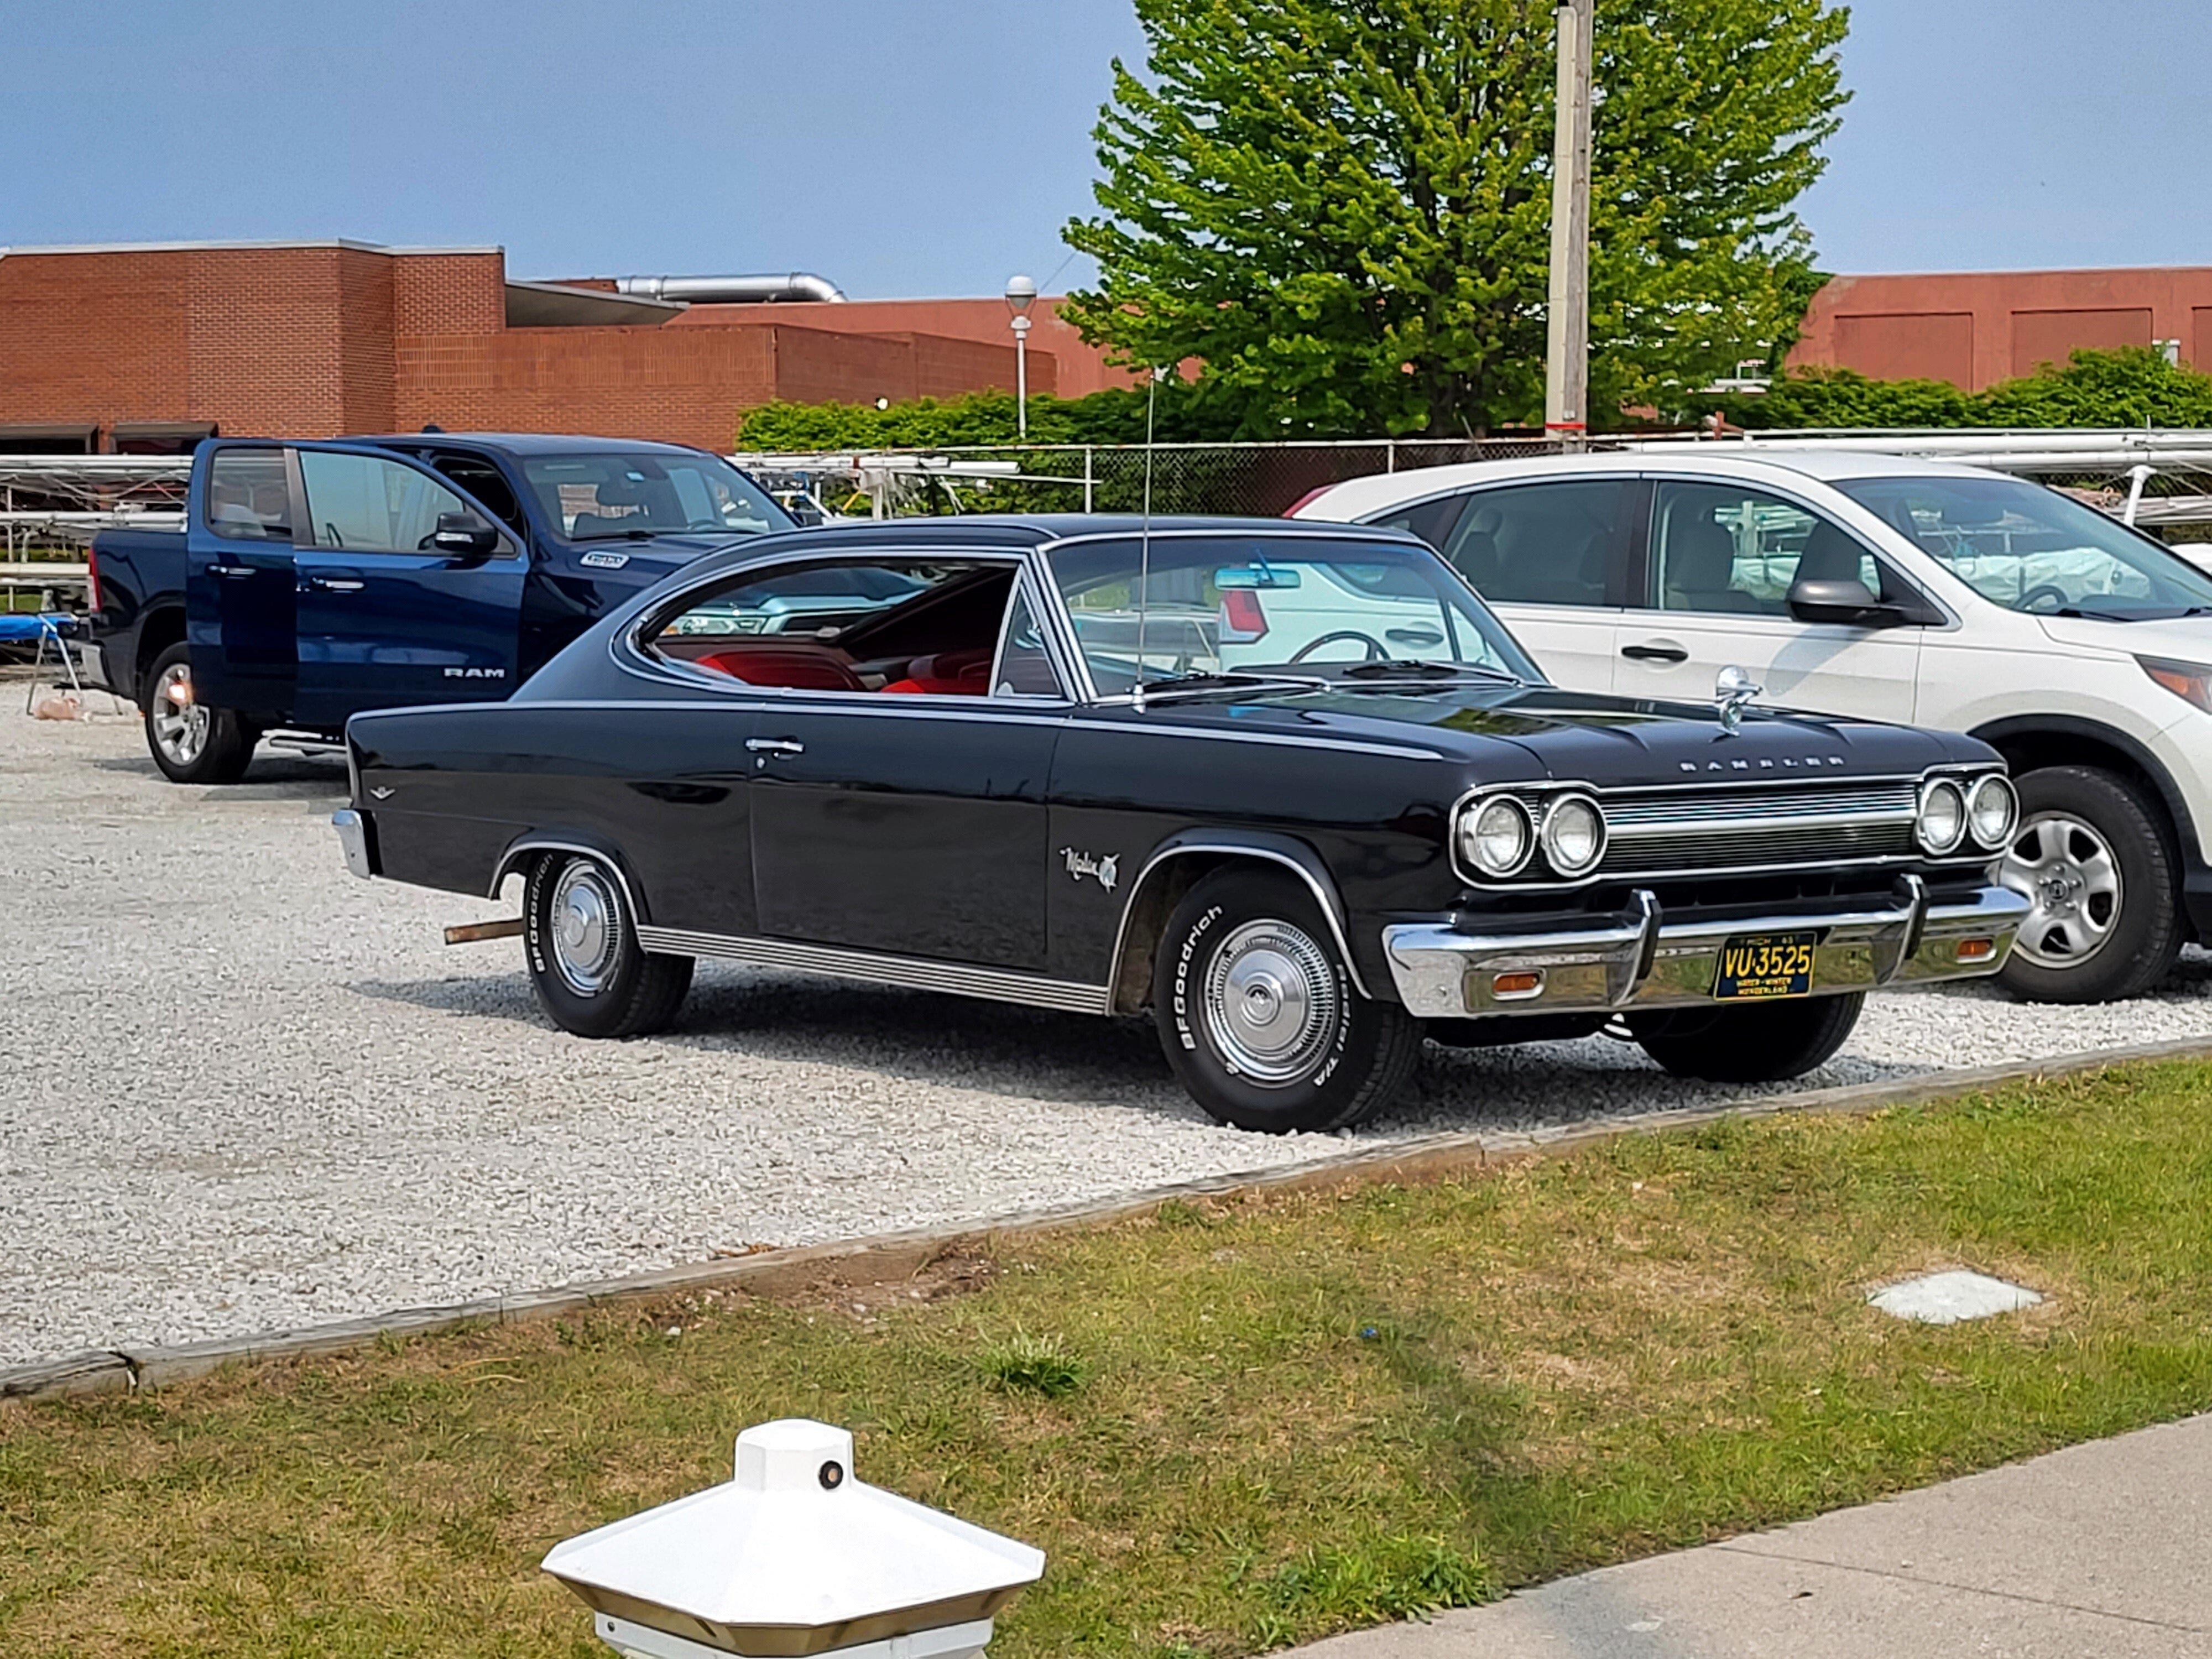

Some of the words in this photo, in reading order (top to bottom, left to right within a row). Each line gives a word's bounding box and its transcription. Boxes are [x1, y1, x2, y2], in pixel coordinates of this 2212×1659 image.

[444, 668, 504, 677] RAM
[1680, 757, 1844, 772] RAMBLER
[1174, 905, 1223, 1049] BFGoodrich
